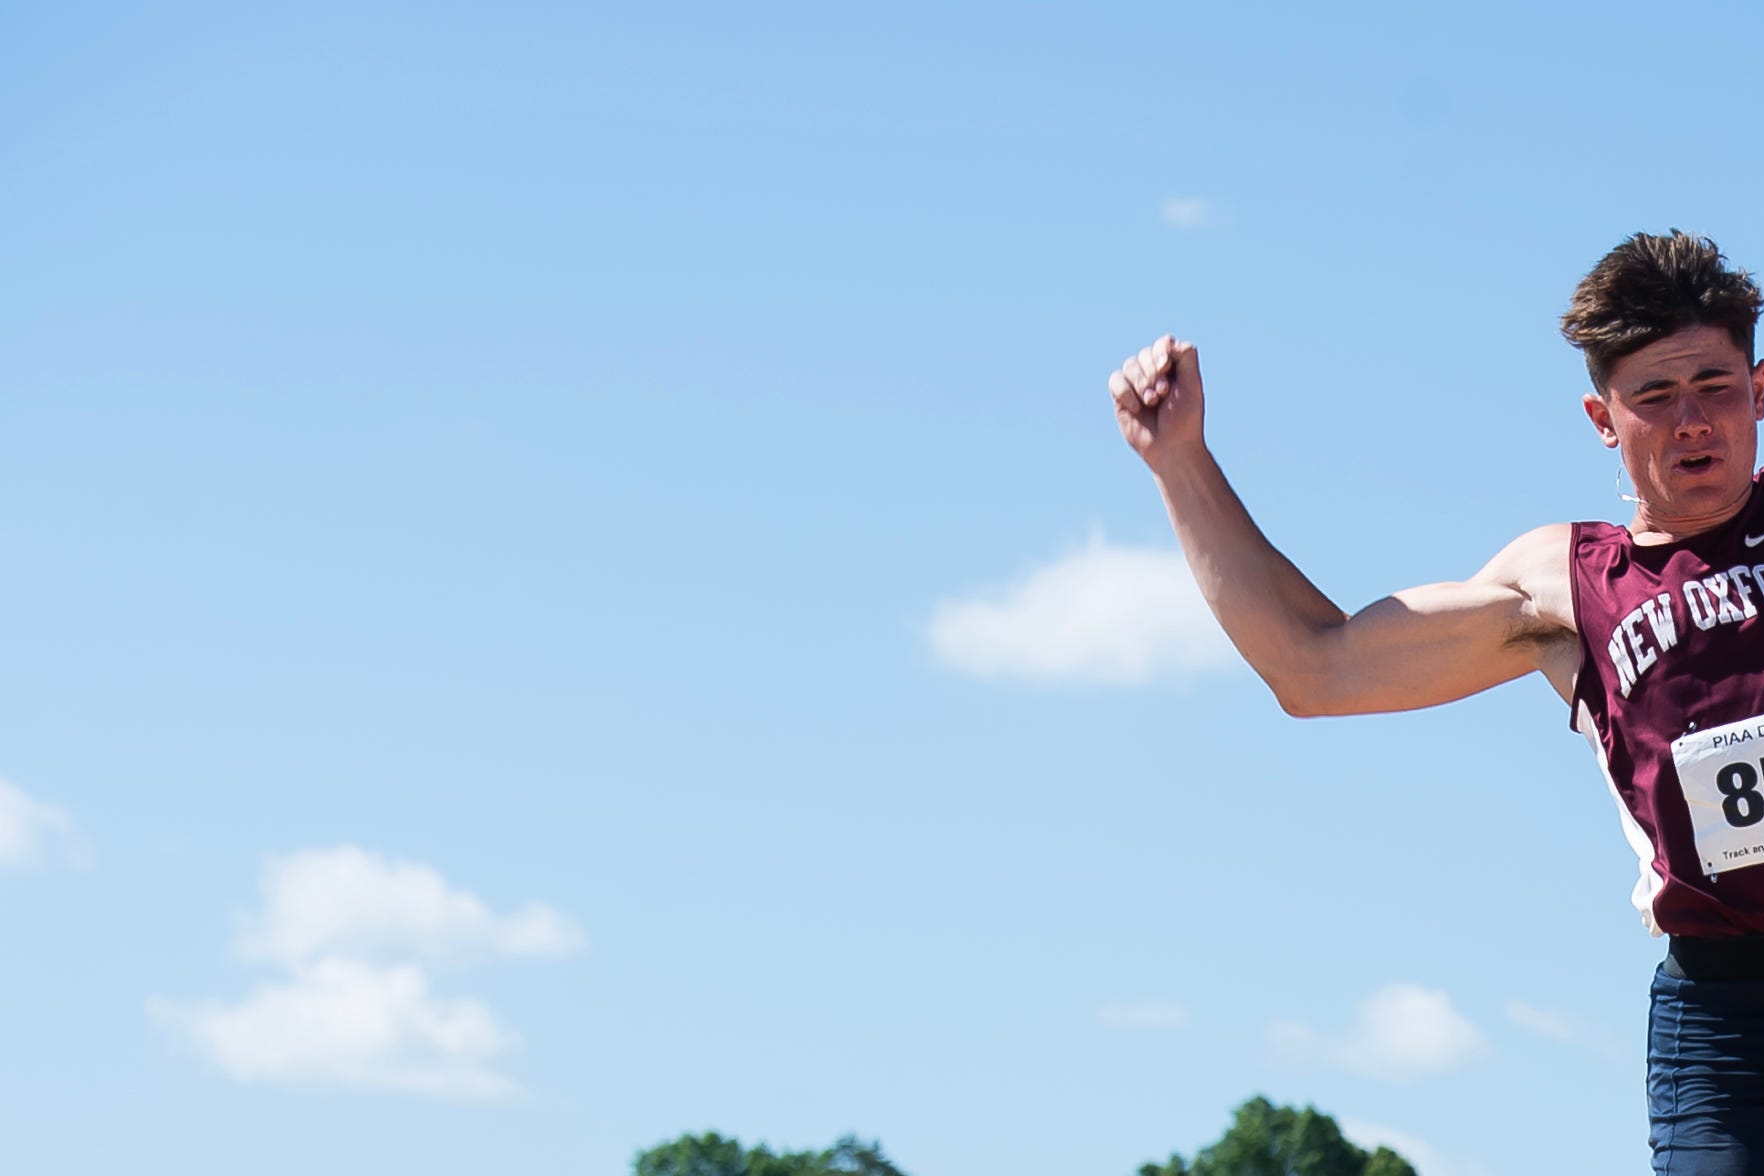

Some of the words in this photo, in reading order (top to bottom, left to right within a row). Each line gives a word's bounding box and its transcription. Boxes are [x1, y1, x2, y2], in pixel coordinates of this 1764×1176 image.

[1608, 593, 1678, 699] NEW
[1712, 729, 1754, 749] PIAA
[1722, 848, 1749, 861] Track
